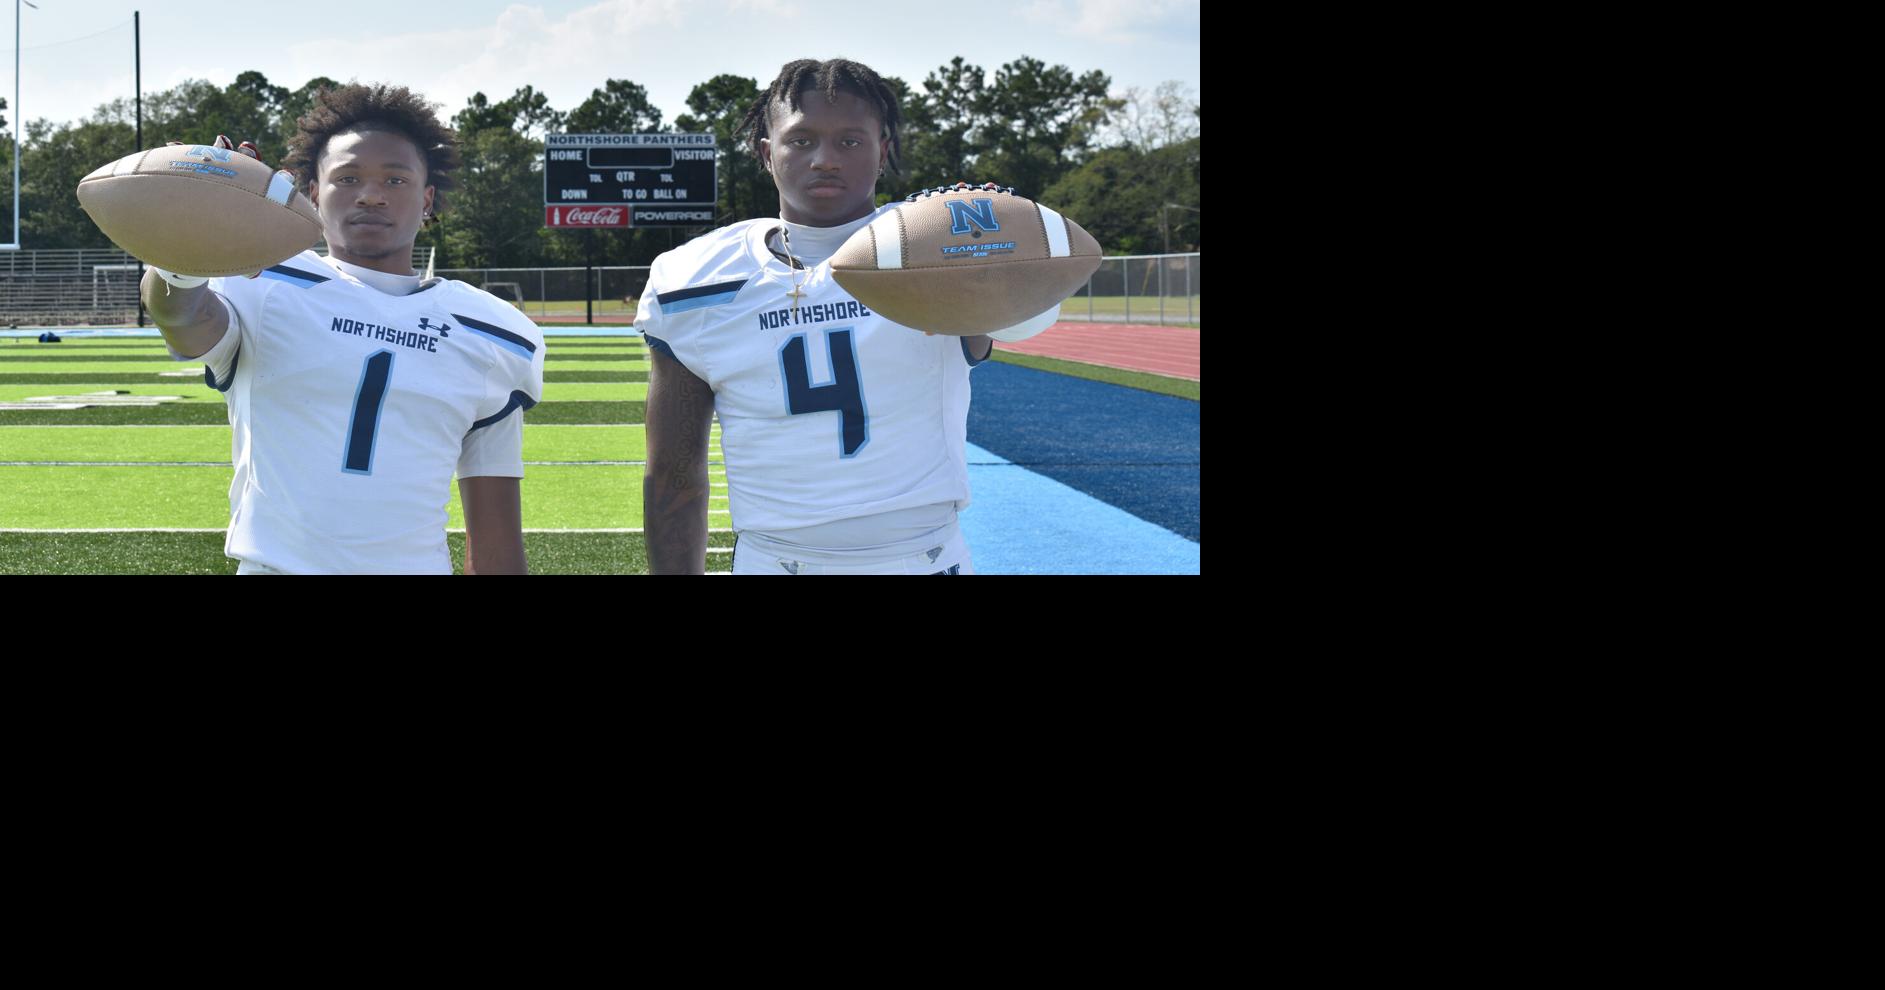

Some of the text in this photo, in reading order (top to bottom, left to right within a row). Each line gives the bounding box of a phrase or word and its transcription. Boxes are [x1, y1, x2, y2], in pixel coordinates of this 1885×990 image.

[550, 135, 712, 145] NORTHSHORE PANTHERS
[550, 150, 583, 160] HOME
[674, 150, 714, 160] VISITOR
[589, 174, 603, 183] TOL
[616, 171, 635, 183] QTR
[660, 174, 674, 183] TOL
[561, 189, 588, 199] DOWN
[622, 189, 647, 199] TO GO
[653, 189, 687, 199] BALL ON
[635, 211, 713, 221] POWERADE
[945, 198, 1000, 235] N
[942, 241, 1017, 254] TEAM ISSUE
[759, 301, 871, 330] NORTHSHORE
[331, 317, 439, 352] NORTHSHORE
[777, 326, 870, 459] 4
[341, 348, 396, 476] 1
